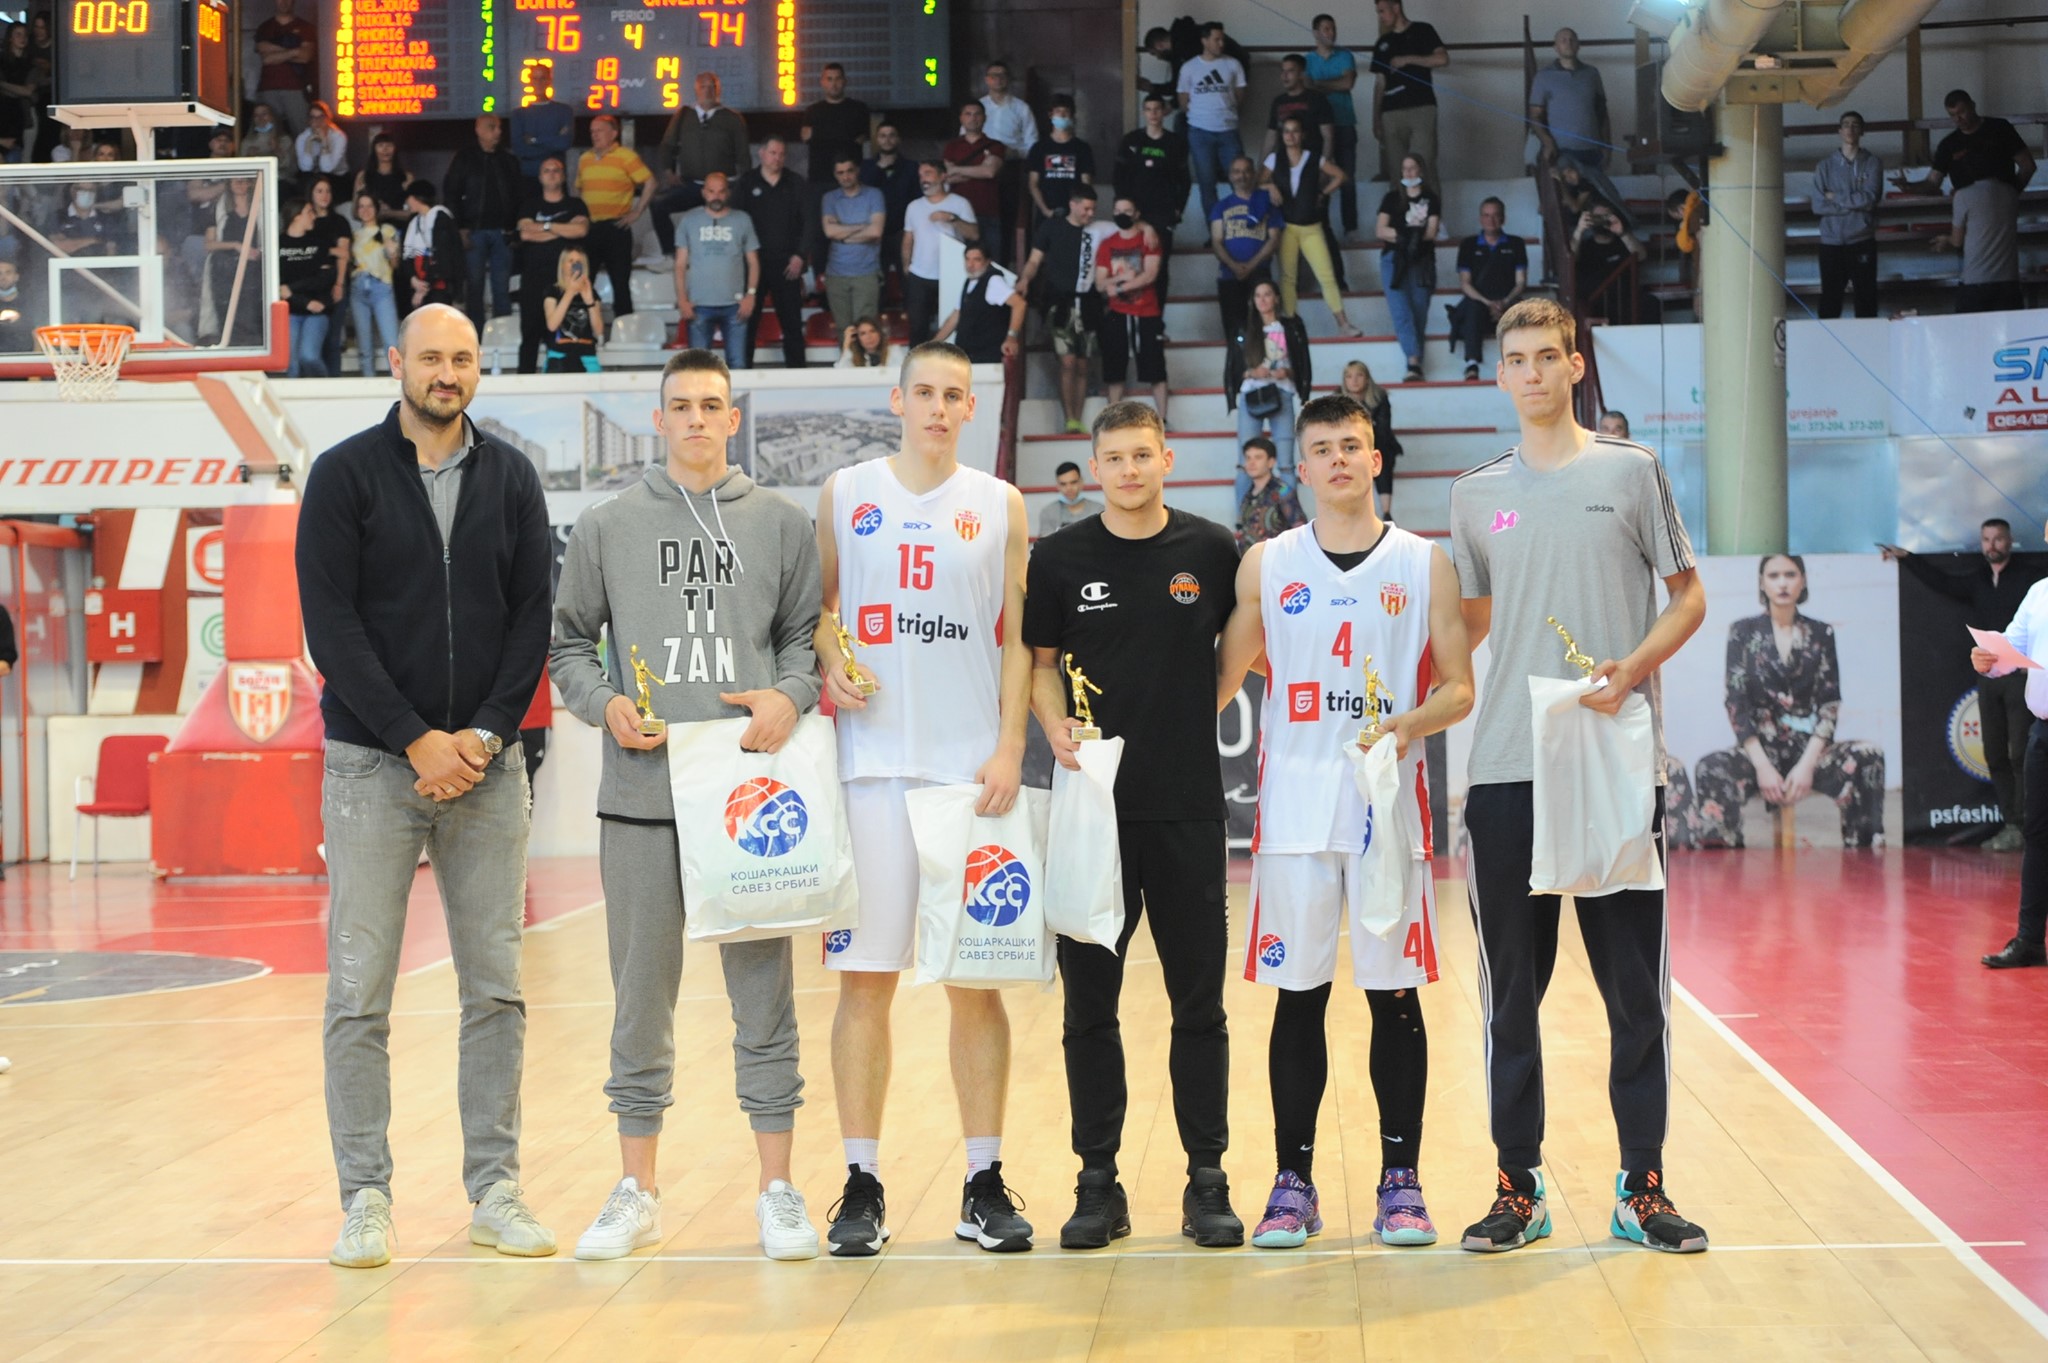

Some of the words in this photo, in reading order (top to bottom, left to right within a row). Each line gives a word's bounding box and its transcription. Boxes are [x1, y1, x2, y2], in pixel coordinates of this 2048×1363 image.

[73, 1, 149, 33] 00:0
[611, 10, 655, 22] PERIOD
[536, 15, 581, 51] 76
[624, 24, 643, 49] 4
[699, 12, 745, 47] 74
[336, 43, 353, 57] 11
[595, 57, 618, 80] 18
[656, 57, 679, 79] 14
[587, 85, 619, 109] 27
[663, 83, 679, 107] 5
[699, 226, 733, 242] 1935
[0, 458, 244, 486] ТОПРЕВ
[1585, 505, 1615, 513] adidas
[658, 538, 735, 586] PAR
[897, 544, 935, 591] 15
[1169, 582, 1200, 595] DYNAMIC
[680, 586, 715, 633] TI
[1077, 602, 1118, 612] Champion
[109, 612, 135, 638] H
[897, 613, 969, 644] triglav
[1331, 621, 1353, 667] 4
[663, 637, 736, 683] ZAN
[1326, 690, 1393, 719] trigav
[1930, 804, 2003, 828] psfashi
[730, 864, 819, 881] КОШАРКАШКИ
[732, 881, 772, 895] САВЕЗ
[775, 877, 820, 892] СРБИЈЕ
[958, 937, 1036, 947] КОШАРКАШКИ
[1403, 921, 1422, 967] 4
[959, 950, 995, 960] САВЕЗ
[997, 951, 1036, 960] СРБИЈЕ
